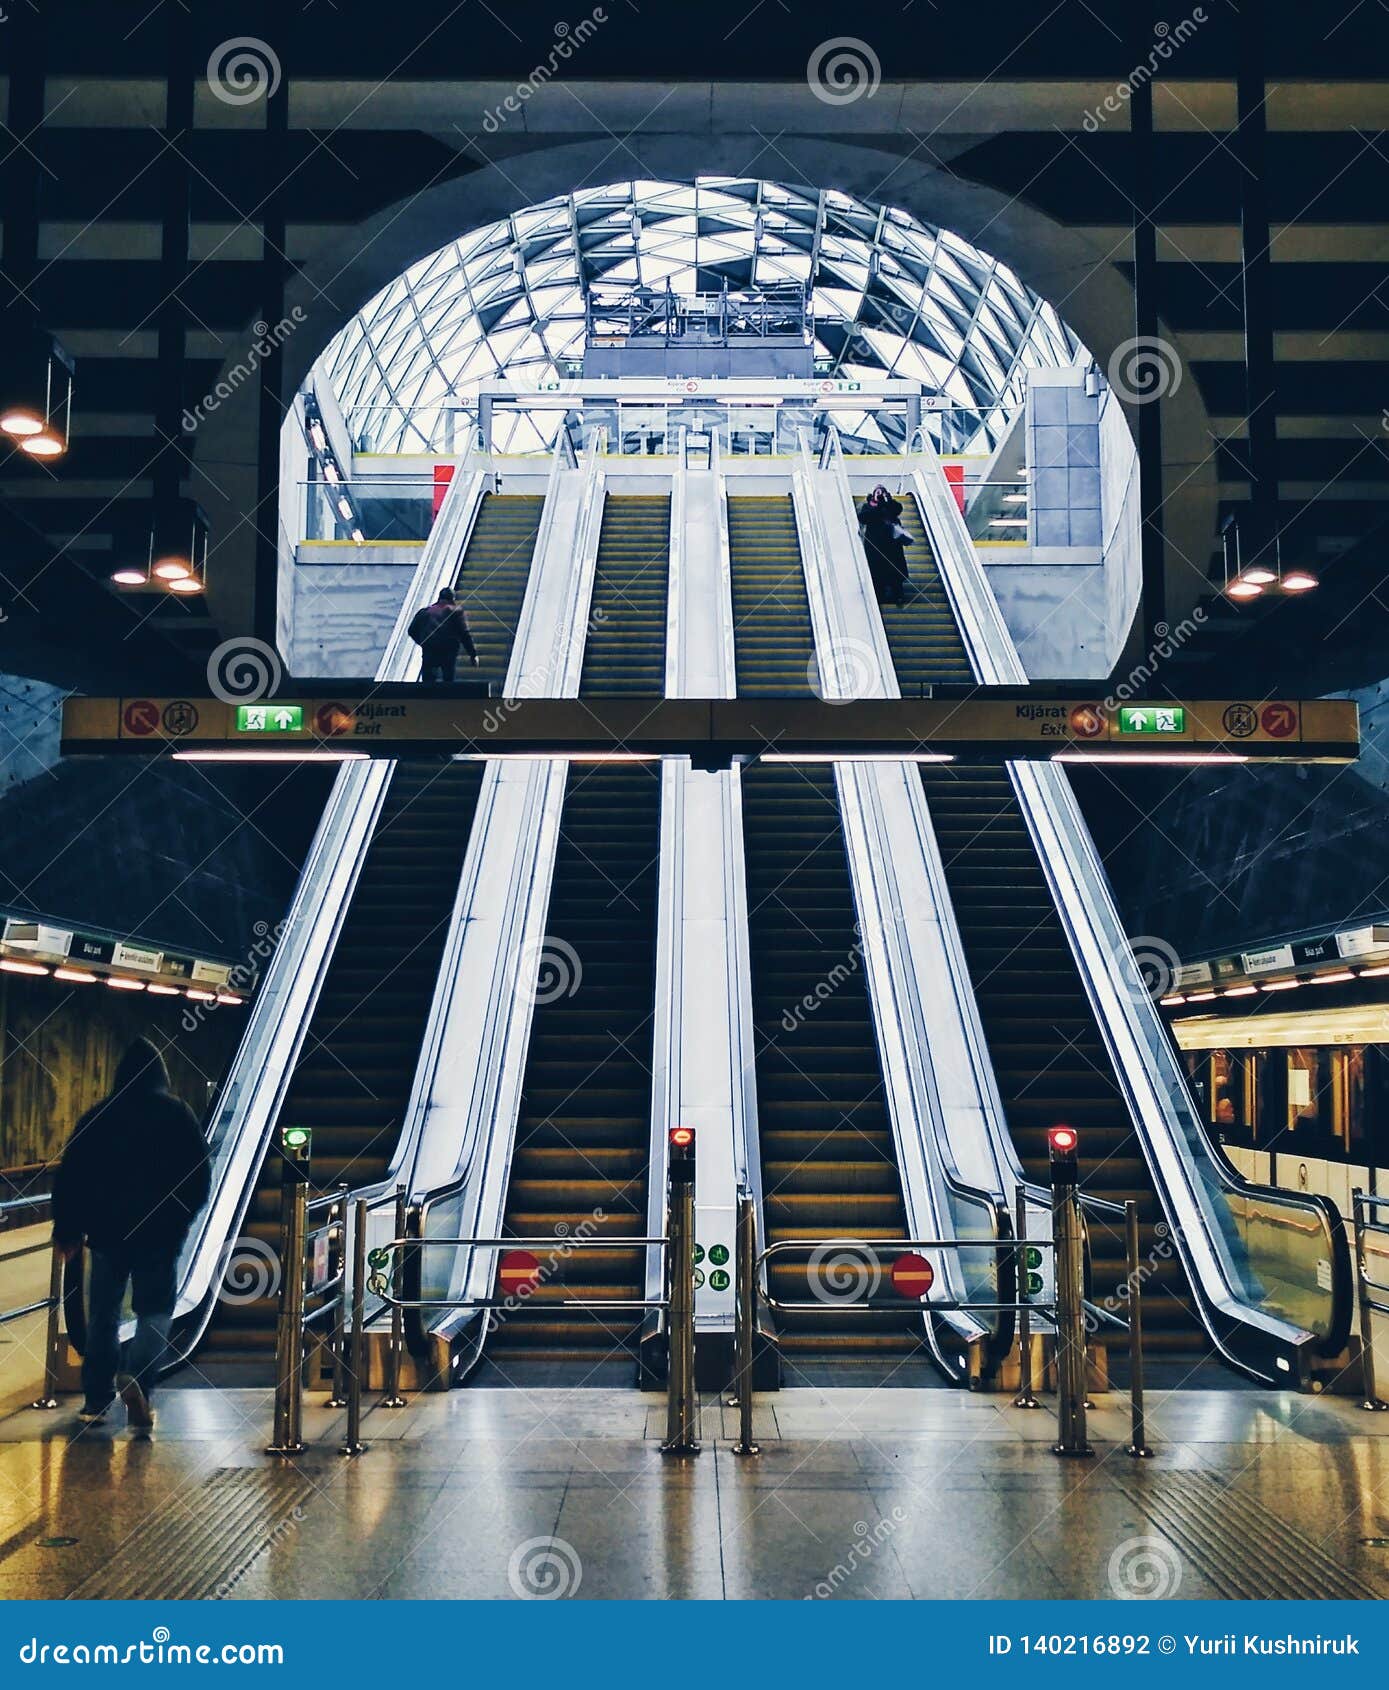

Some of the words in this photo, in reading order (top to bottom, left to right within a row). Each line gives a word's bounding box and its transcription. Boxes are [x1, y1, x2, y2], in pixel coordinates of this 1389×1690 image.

[1016, 705, 1067, 720] Kijárat
[354, 722, 383, 735] Exit
[1041, 723, 1067, 736] Exit
